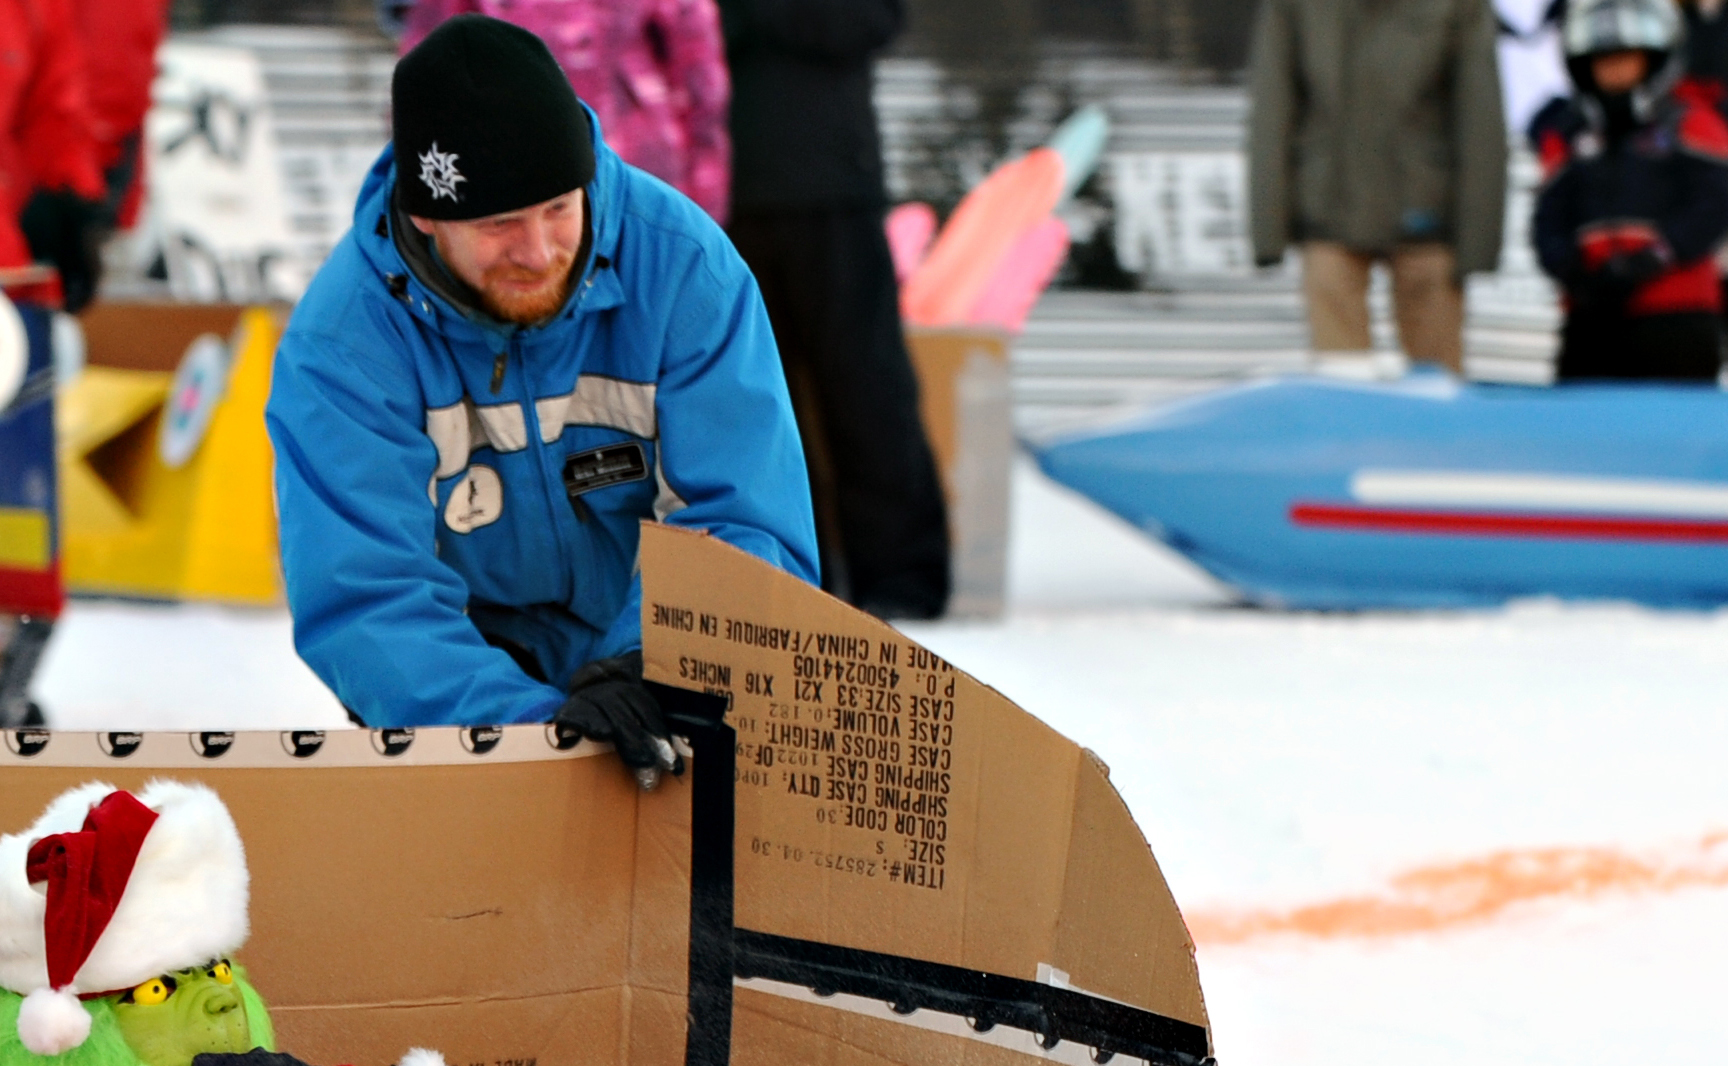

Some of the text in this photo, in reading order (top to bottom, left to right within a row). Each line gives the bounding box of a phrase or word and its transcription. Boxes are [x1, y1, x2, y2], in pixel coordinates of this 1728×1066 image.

[652, 604, 693, 633] CHINE
[700, 614, 717, 638] EN
[879, 643, 897, 665] IN
[679, 657, 731, 686] INCHES
[793, 656, 899, 686] 4500244105
[746, 674, 773, 696] X16
[795, 680, 822, 702] X21
[909, 696, 953, 721] CASE
[765, 721, 835, 751] WEIGHT:
[909, 719, 952, 745] CASE
[842, 735, 899, 763] GROSS
[908, 745, 951, 769] CASE
[827, 756, 866, 780] CASE
[875, 764, 950, 792] SHIPPING
[735, 770, 947, 816] SHIPPING CASE QTY: 10P
[895, 813, 946, 841] COLOR
[903, 839, 945, 865] SIZE:
